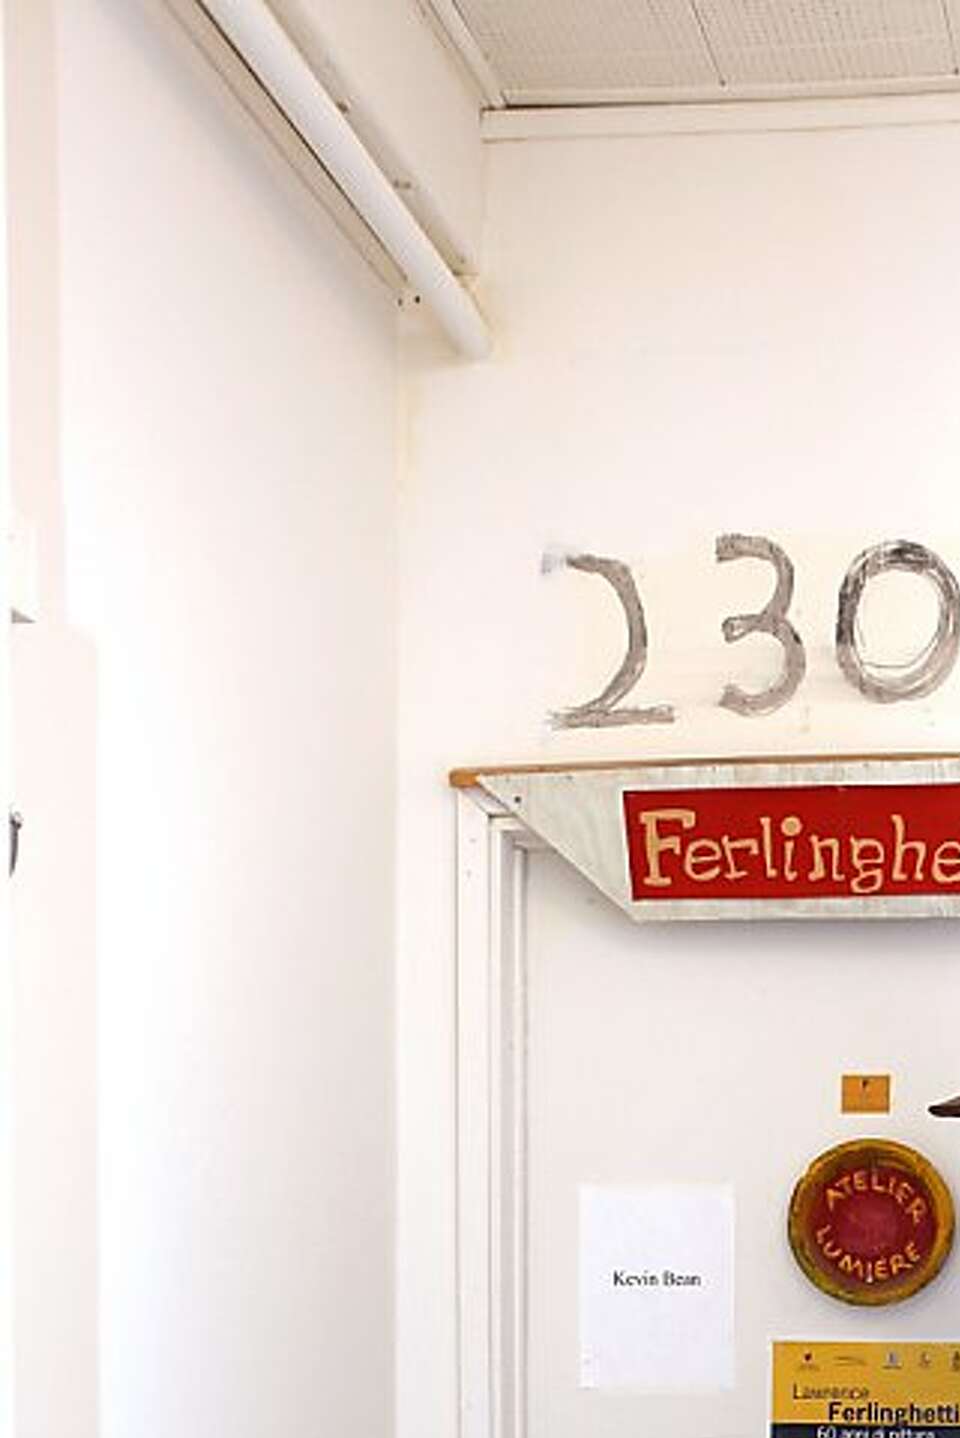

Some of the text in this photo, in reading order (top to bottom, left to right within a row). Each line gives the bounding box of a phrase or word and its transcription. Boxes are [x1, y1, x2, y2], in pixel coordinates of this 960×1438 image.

[825, 1170, 927, 1224] ATELIER
[613, 1269, 702, 1286] Kevin Bean
[792, 1383, 869, 1401] Lawrence
[828, 1402, 960, 1426] Ferlinghetti
